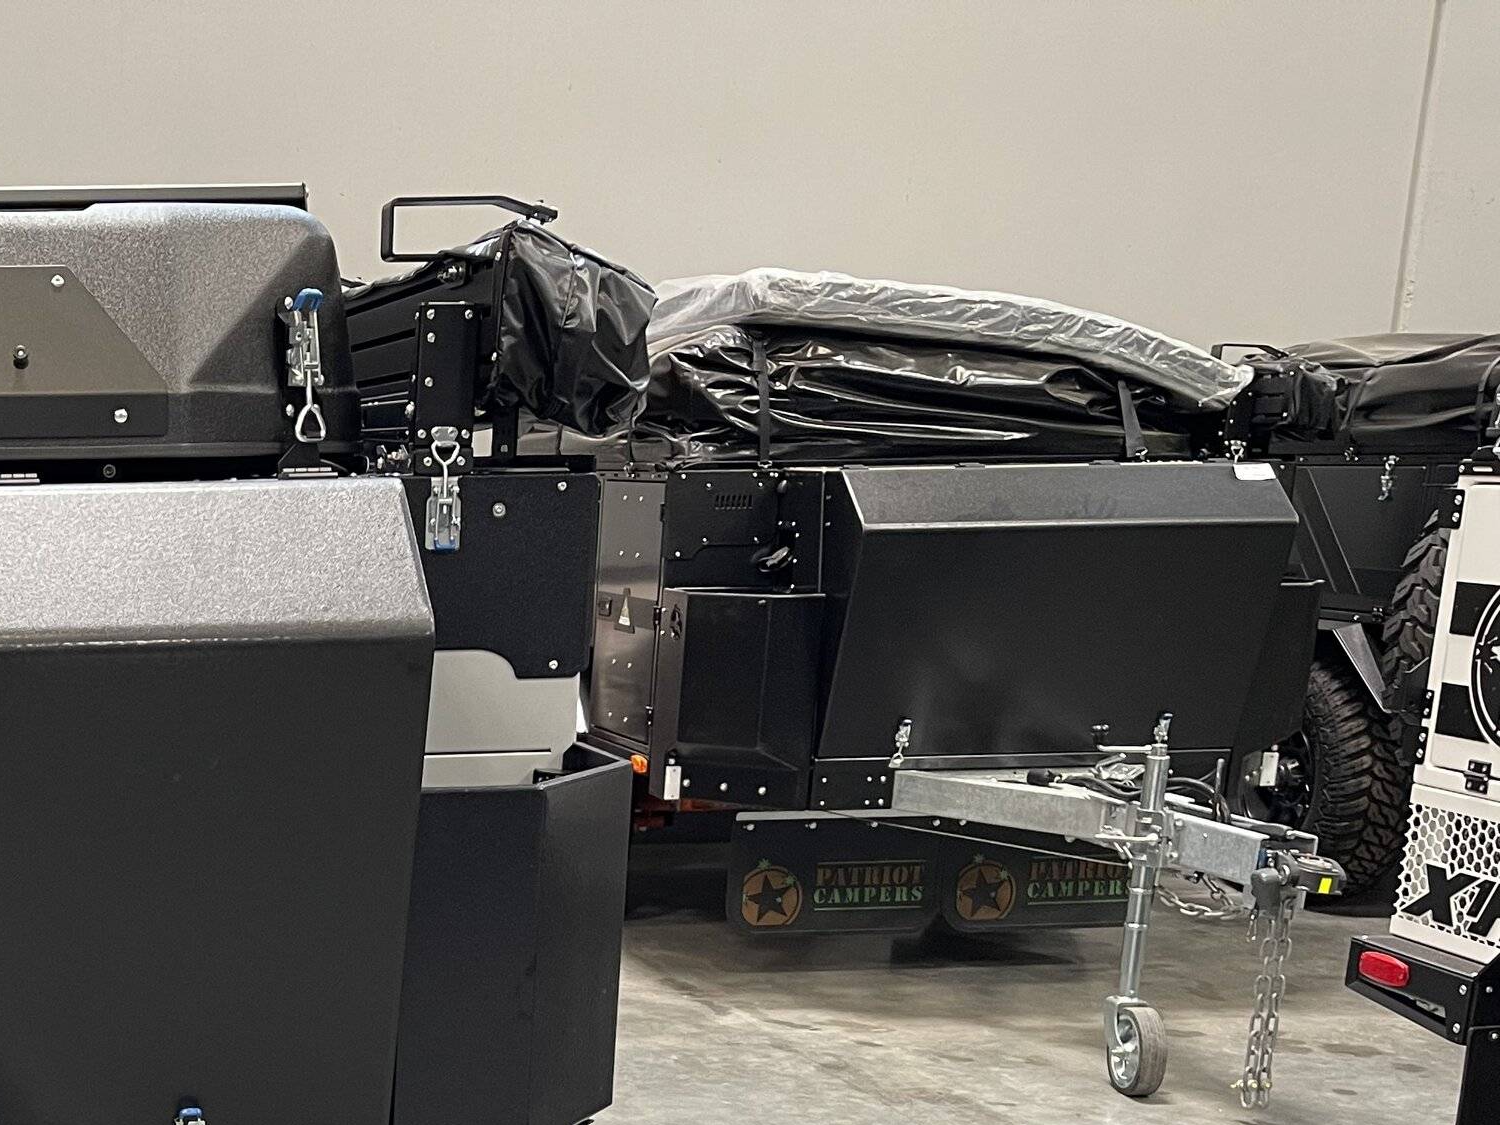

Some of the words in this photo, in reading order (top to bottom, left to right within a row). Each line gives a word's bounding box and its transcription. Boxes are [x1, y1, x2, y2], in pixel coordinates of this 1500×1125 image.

[815, 864, 926, 888] PATRIOT
[1029, 860, 1131, 881] PATRIO
[813, 885, 924, 904] CAMPERS
